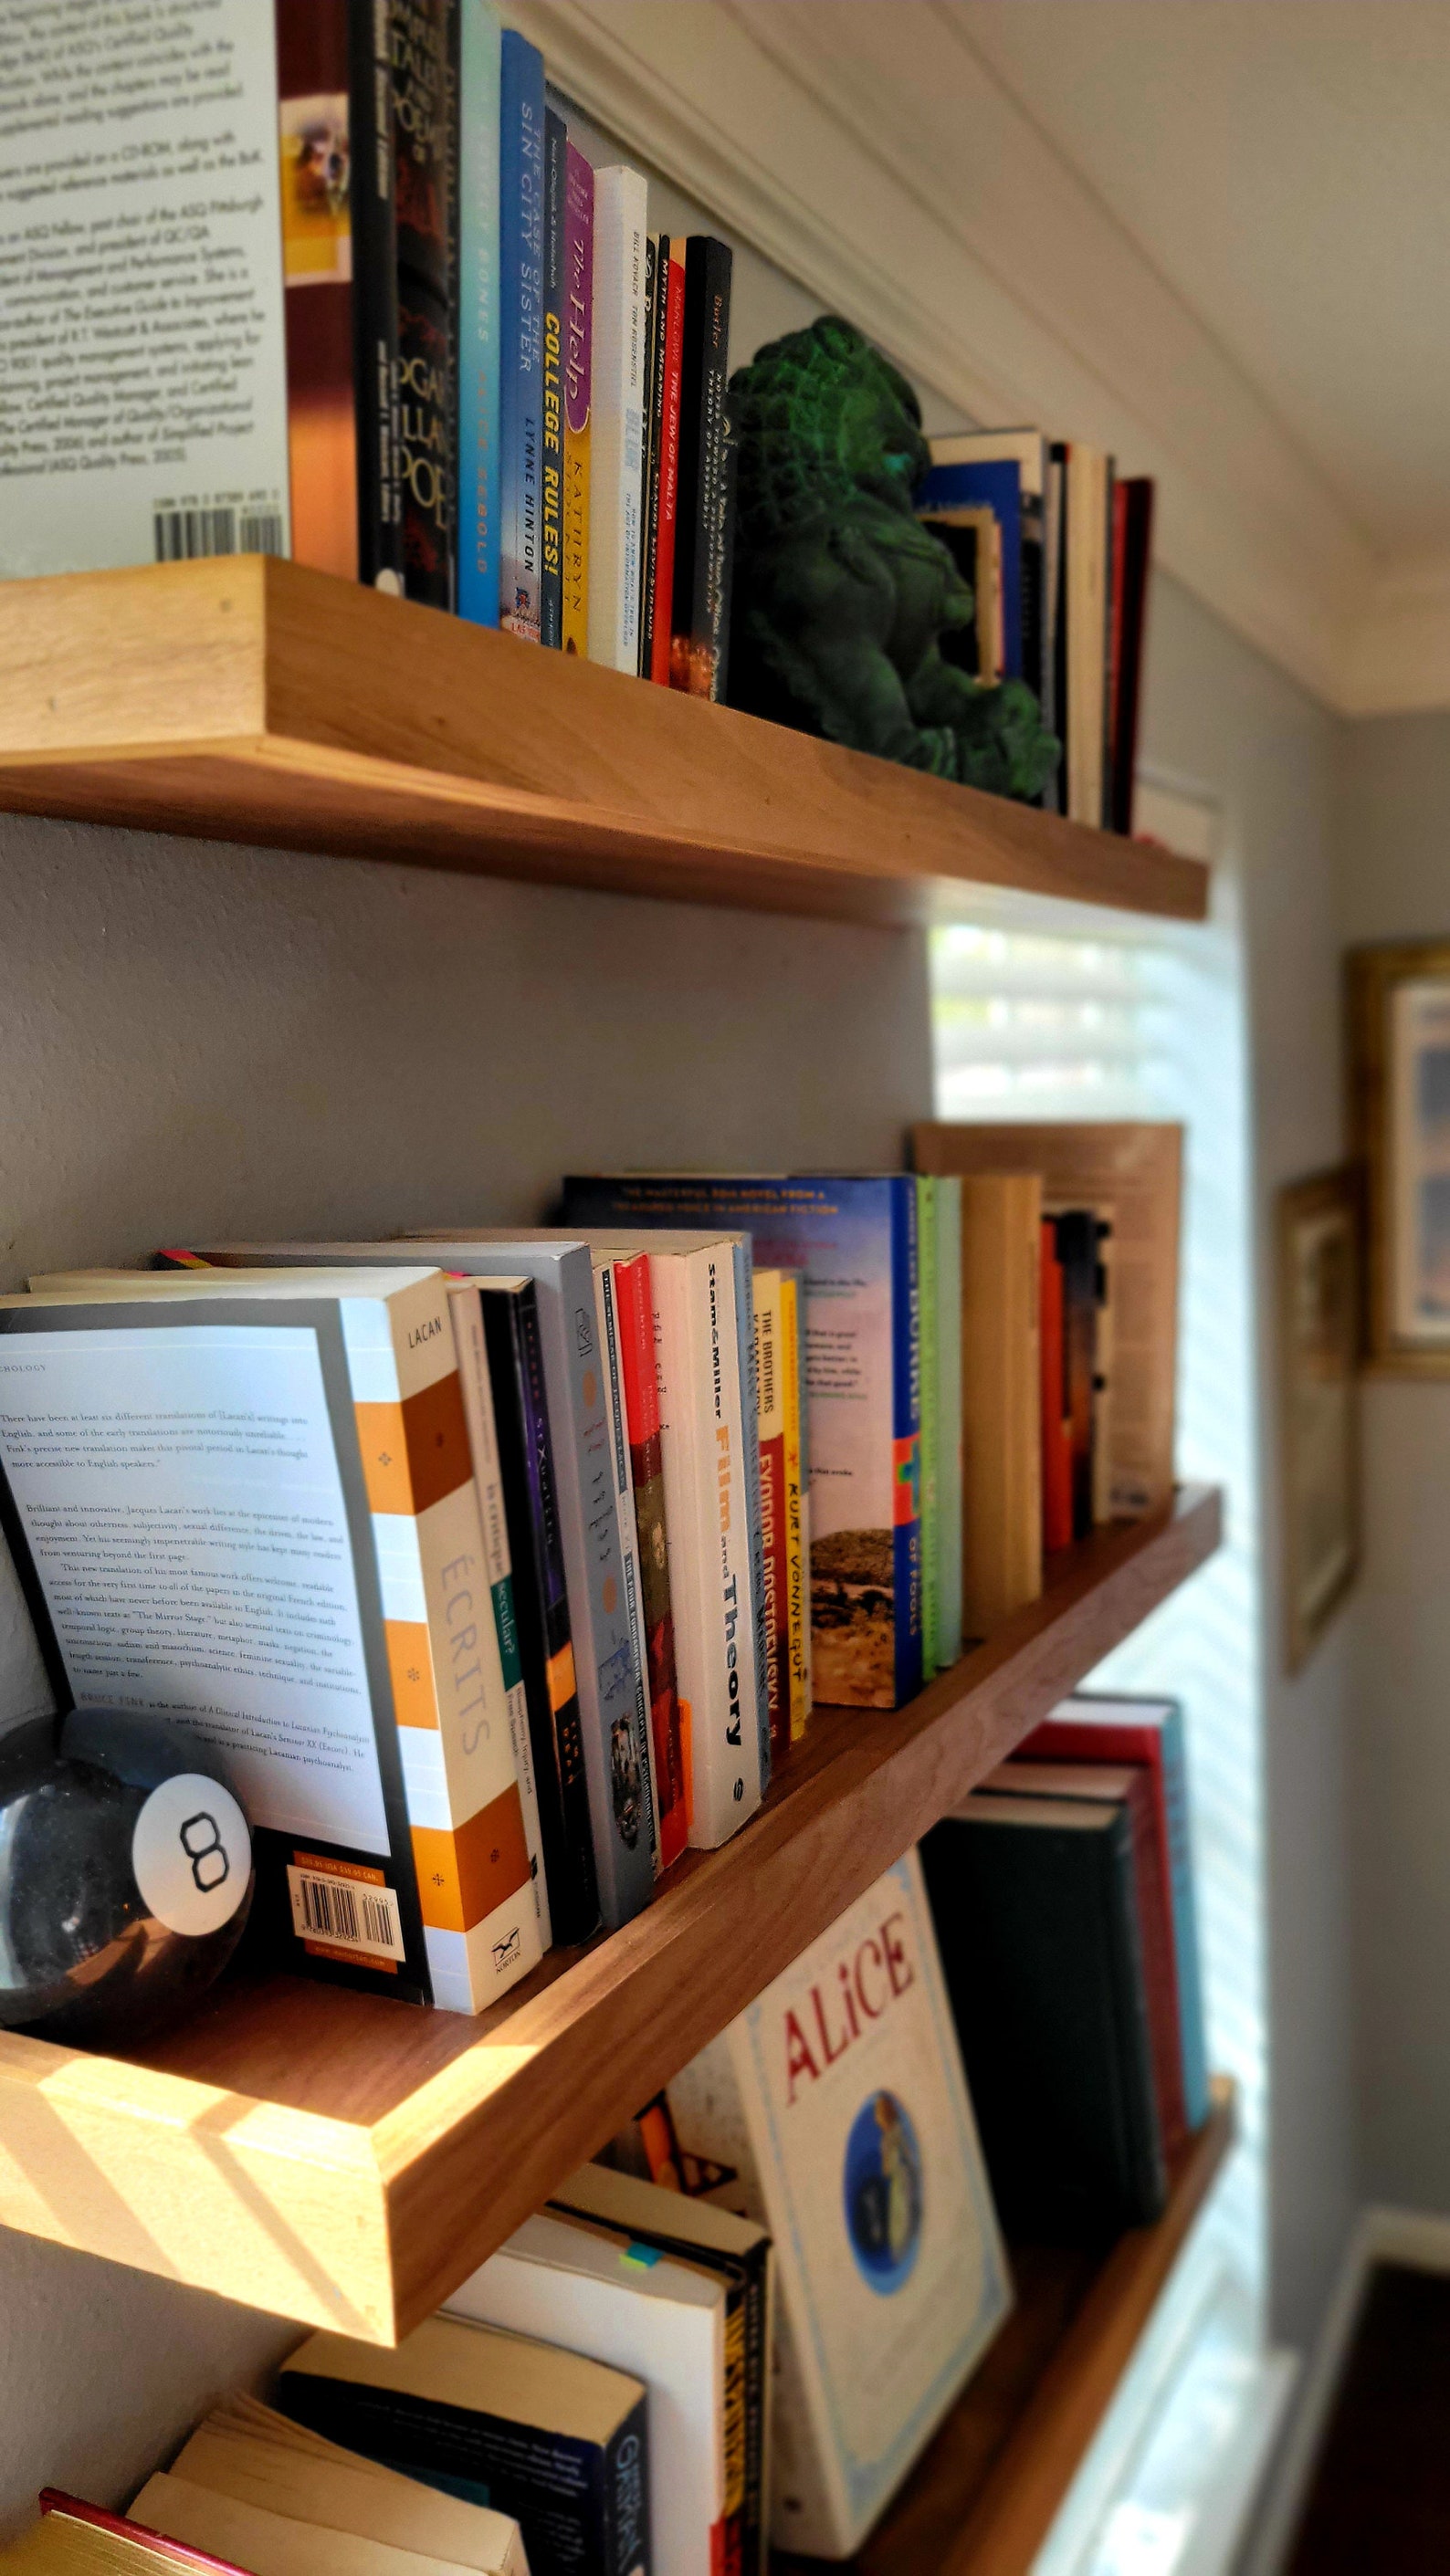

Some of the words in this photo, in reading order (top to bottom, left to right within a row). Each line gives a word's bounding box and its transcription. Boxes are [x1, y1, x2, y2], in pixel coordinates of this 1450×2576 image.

[520, 102, 532, 157] SIN
[532, 130, 543, 179] THE
[520, 173, 533, 248] CITY
[572, 238, 586, 288] The
[660, 258, 669, 304] MYTH
[478, 247, 490, 342] BONES
[520, 262, 532, 372] SISTER
[712, 292, 723, 350] Butler
[564, 293, 586, 400] Help
[477, 369, 488, 448] ALICE
[544, 311, 562, 452] COLLEGE
[656, 348, 665, 418] MEANING
[668, 370, 680, 403] THE
[708, 369, 716, 425] THEORY
[714, 372, 722, 421] NOTES
[667, 404, 679, 442] JEW
[706, 431, 713, 449] OF
[524, 417, 536, 485] LYNNE
[667, 444, 678, 464] OF
[477, 467, 488, 574] SEBOLD
[664, 466, 676, 520] MALTA
[524, 494, 536, 574] HINTON
[544, 466, 560, 576] RULES!
[572, 461, 583, 613] KATHRYN
[408, 1315, 443, 1350] LACAN
[762, 1310, 773, 1336] THE
[762, 1341, 774, 1414] BROTHERS
[27, 1413, 47, 1422] have
[48, 1412, 68, 1422] been
[80, 1411, 100, 1421] least
[115, 1411, 153, 1421] different
[37, 1428, 54, 1437] and
[79, 1428, 89, 1437] of
[90, 1428, 104, 1437] the
[106, 1428, 126, 1439] early
[128, 1428, 179, 1437] translations
[196, 1427, 243, 1439] notoriously
[36, 1459, 75, 1468] accessible
[88, 1458, 119, 1470] English
[716, 1424, 731, 1533] Film
[31, 1519, 63, 1530] thought
[65, 1519, 88, 1528] about
[787, 1482, 800, 1547] KURT
[40, 1548, 61, 1556] from
[62, 1549, 101, 1559] venturing
[102, 1549, 131, 1560] beyond
[133, 1550, 147, 1559] the
[149, 1551, 165, 1560] first
[221, 1572, 239, 1580] work
[625, 1559, 633, 1577] THE
[720, 1535, 730, 1578] and
[154, 1611, 184, 1622] Mirror
[626, 1580, 637, 1608] FOUR
[789, 1555, 803, 1680] VONNEGUT
[440, 1553, 491, 1756] ÉCRITS
[721, 1573, 743, 1747] Theory
[180, 1811, 230, 1893] 8
